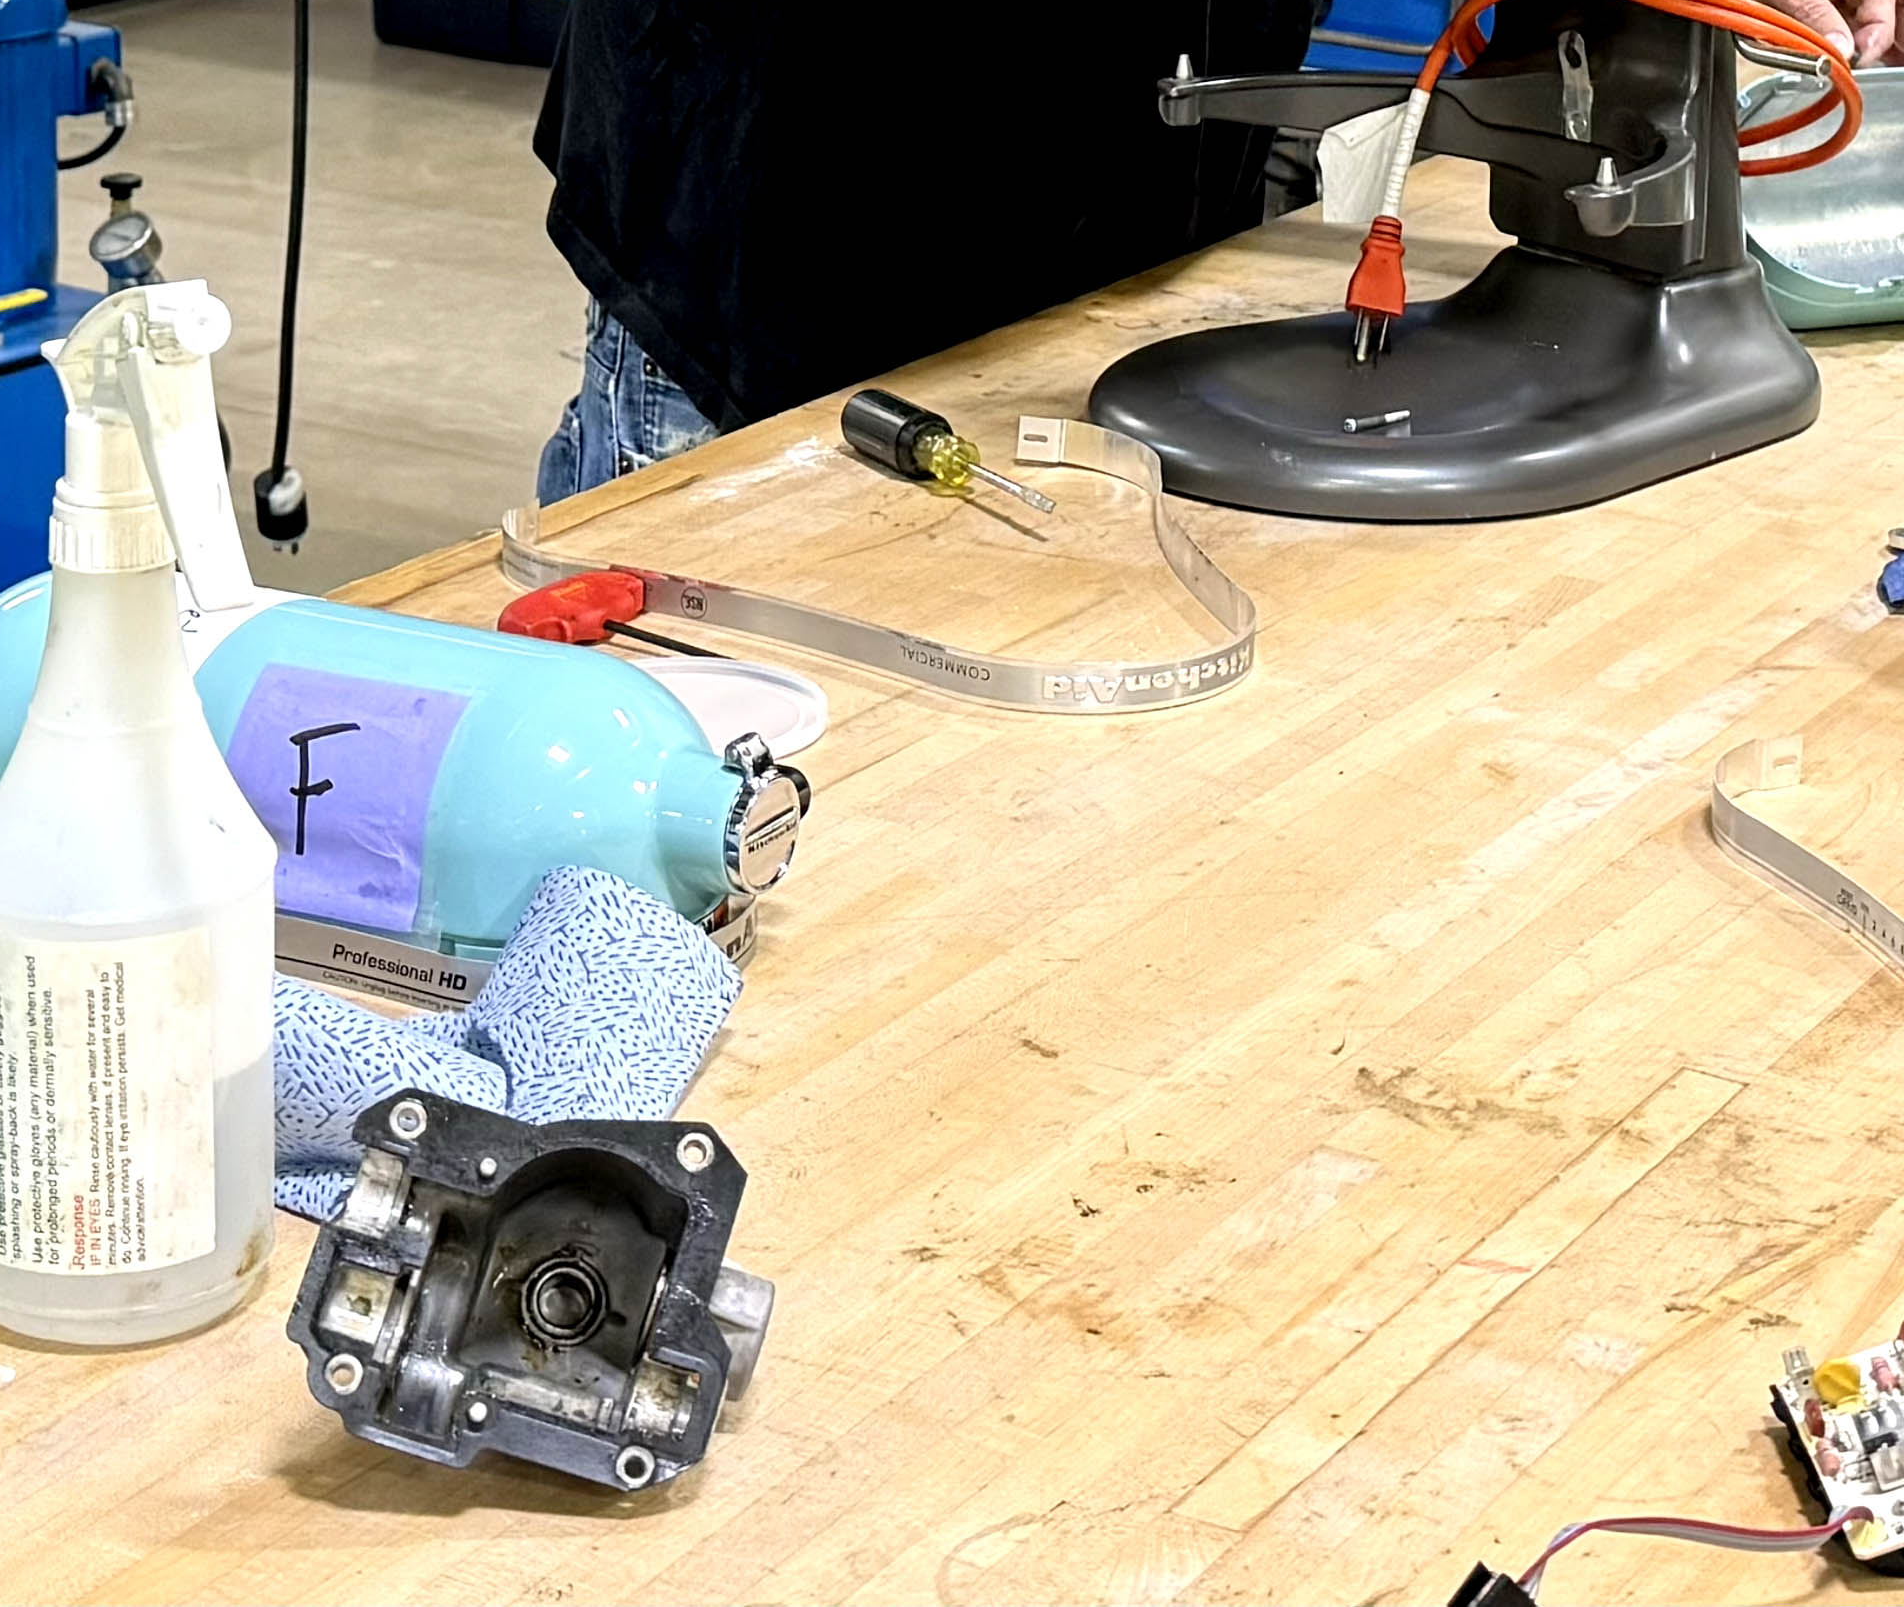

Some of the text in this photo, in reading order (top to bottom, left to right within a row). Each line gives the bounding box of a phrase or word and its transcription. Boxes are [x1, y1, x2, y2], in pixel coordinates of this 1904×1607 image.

[899, 644, 991, 682] COMMERCIAL
[1042, 644, 1250, 704] KitchenAid
[289, 722, 361, 856] F
[100, 972, 109, 982] to
[332, 943, 468, 991] Professional HD
[100, 986, 111, 1011] easy
[86, 1031, 96, 1046] for
[25, 956, 44, 1263] Use protective gloves (any material) when used
[46, 1111, 56, 1124] or
[7, 1105, 19, 1177] spray-back
[119, 1123, 130, 1142] eye
[89, 1162, 100, 1192] Rinse
[105, 1172, 115, 1217] Remove
[9, 1198, 22, 1259] splashing
[47, 1179, 61, 1244] prolonged
[72, 1195, 87, 1267] Response
[48, 1247, 60, 1265] for
